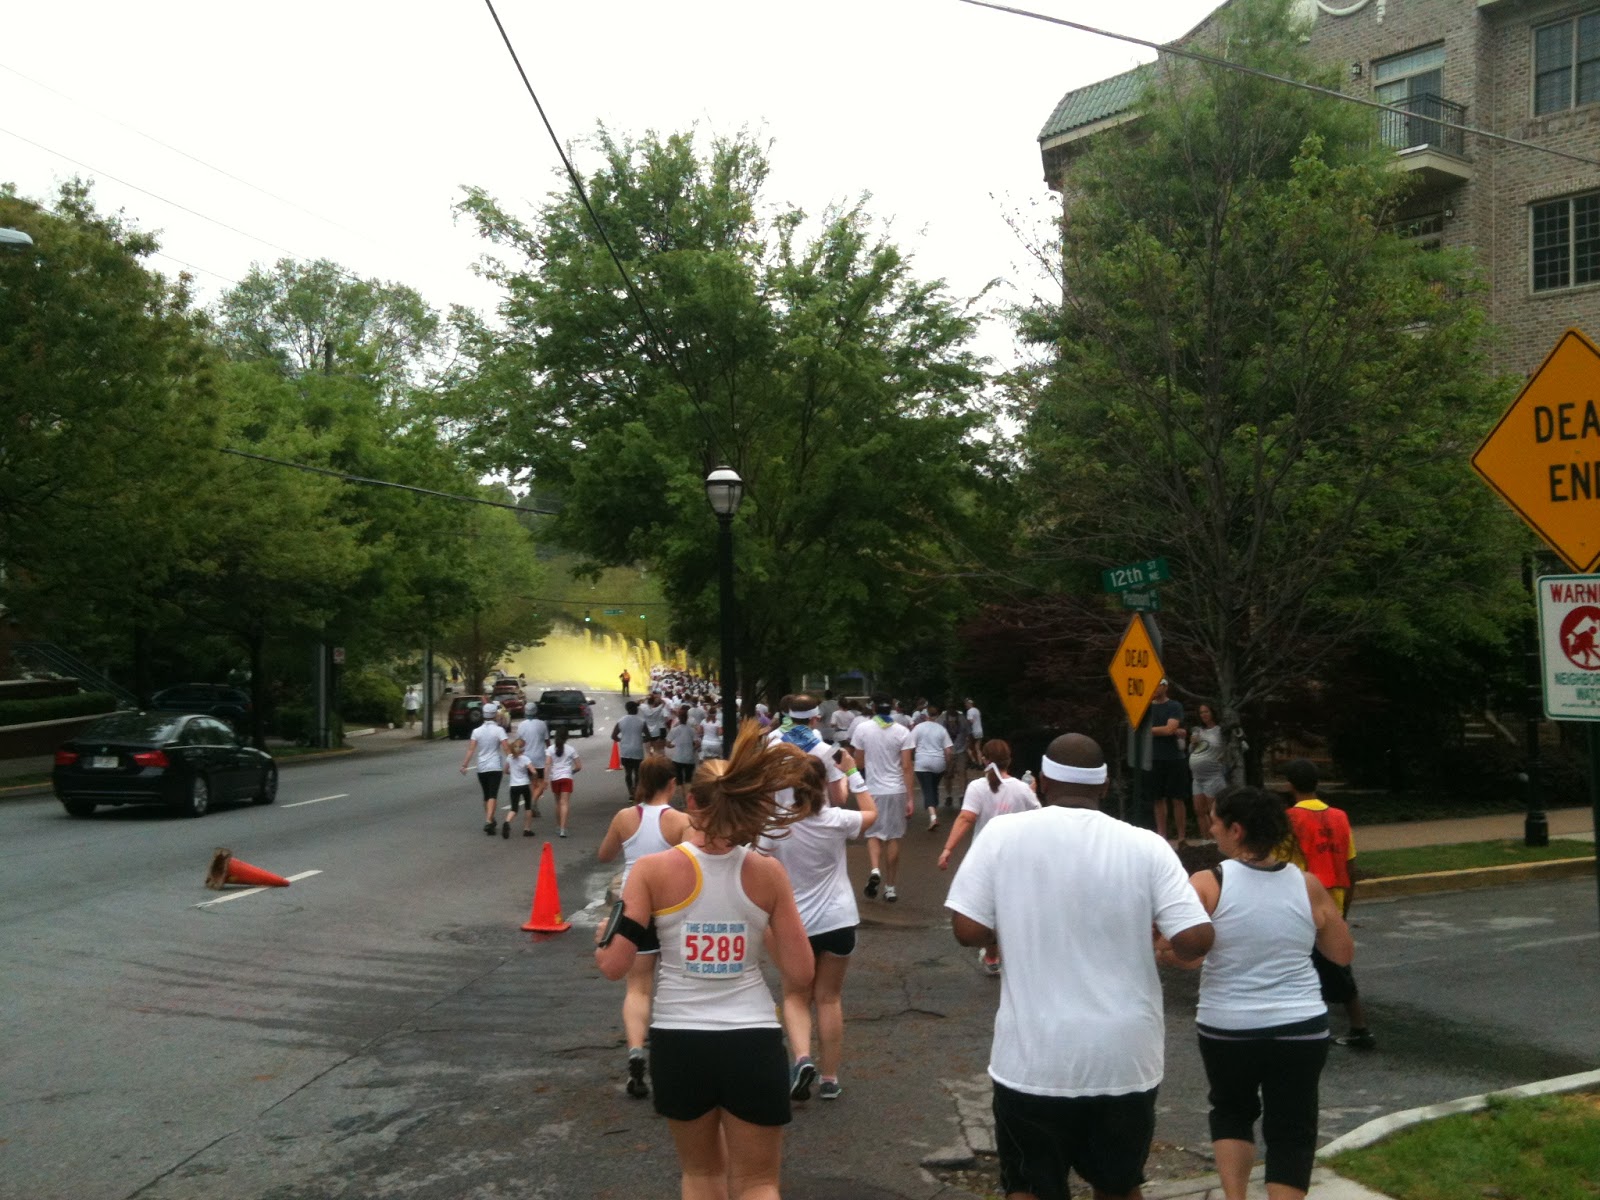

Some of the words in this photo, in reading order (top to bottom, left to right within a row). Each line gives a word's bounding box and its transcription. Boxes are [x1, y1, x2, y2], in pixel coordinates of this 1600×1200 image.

[1534, 400, 1600, 443] DEA
[1147, 560, 1156, 570] ST
[1110, 568, 1143, 588] 12th
[1125, 649, 1149, 668] DEAD
[1128, 678, 1145, 696] END
[686, 923, 701, 933] THE
[702, 923, 728, 933] COLOR
[729, 923, 745, 933] RUN
[685, 935, 745, 962] 5289
[685, 962, 700, 973] THE
[702, 963, 728, 974] COLOR
[729, 963, 743, 973] RUN
